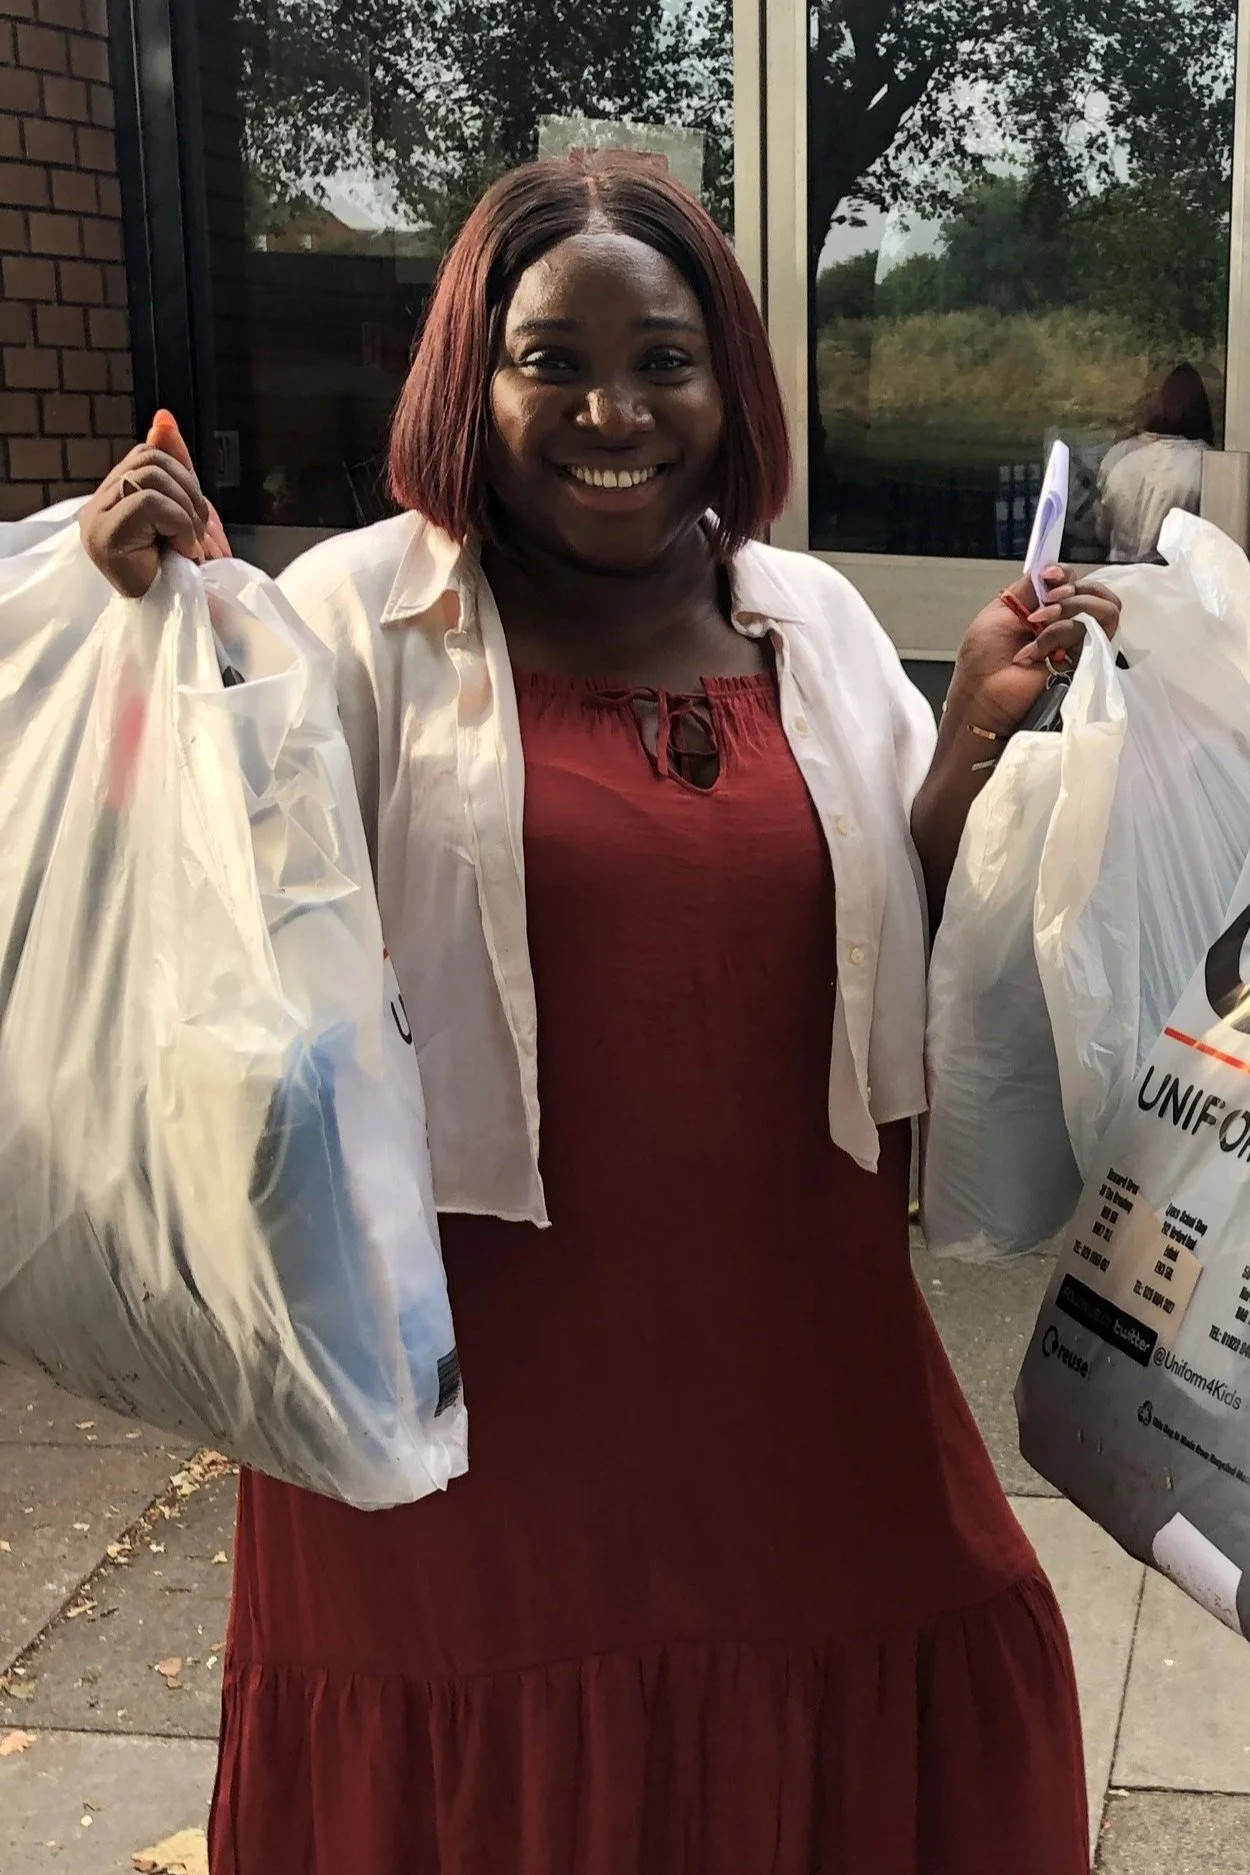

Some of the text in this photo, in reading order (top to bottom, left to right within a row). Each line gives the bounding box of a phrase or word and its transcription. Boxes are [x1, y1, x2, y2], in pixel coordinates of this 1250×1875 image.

[1113, 1319, 1151, 1352] twitter
[1209, 1325, 1223, 1343] TEL:
[1057, 1342, 1089, 1378] reuse
[1153, 1347, 1242, 1411] @Uniform4Kids
